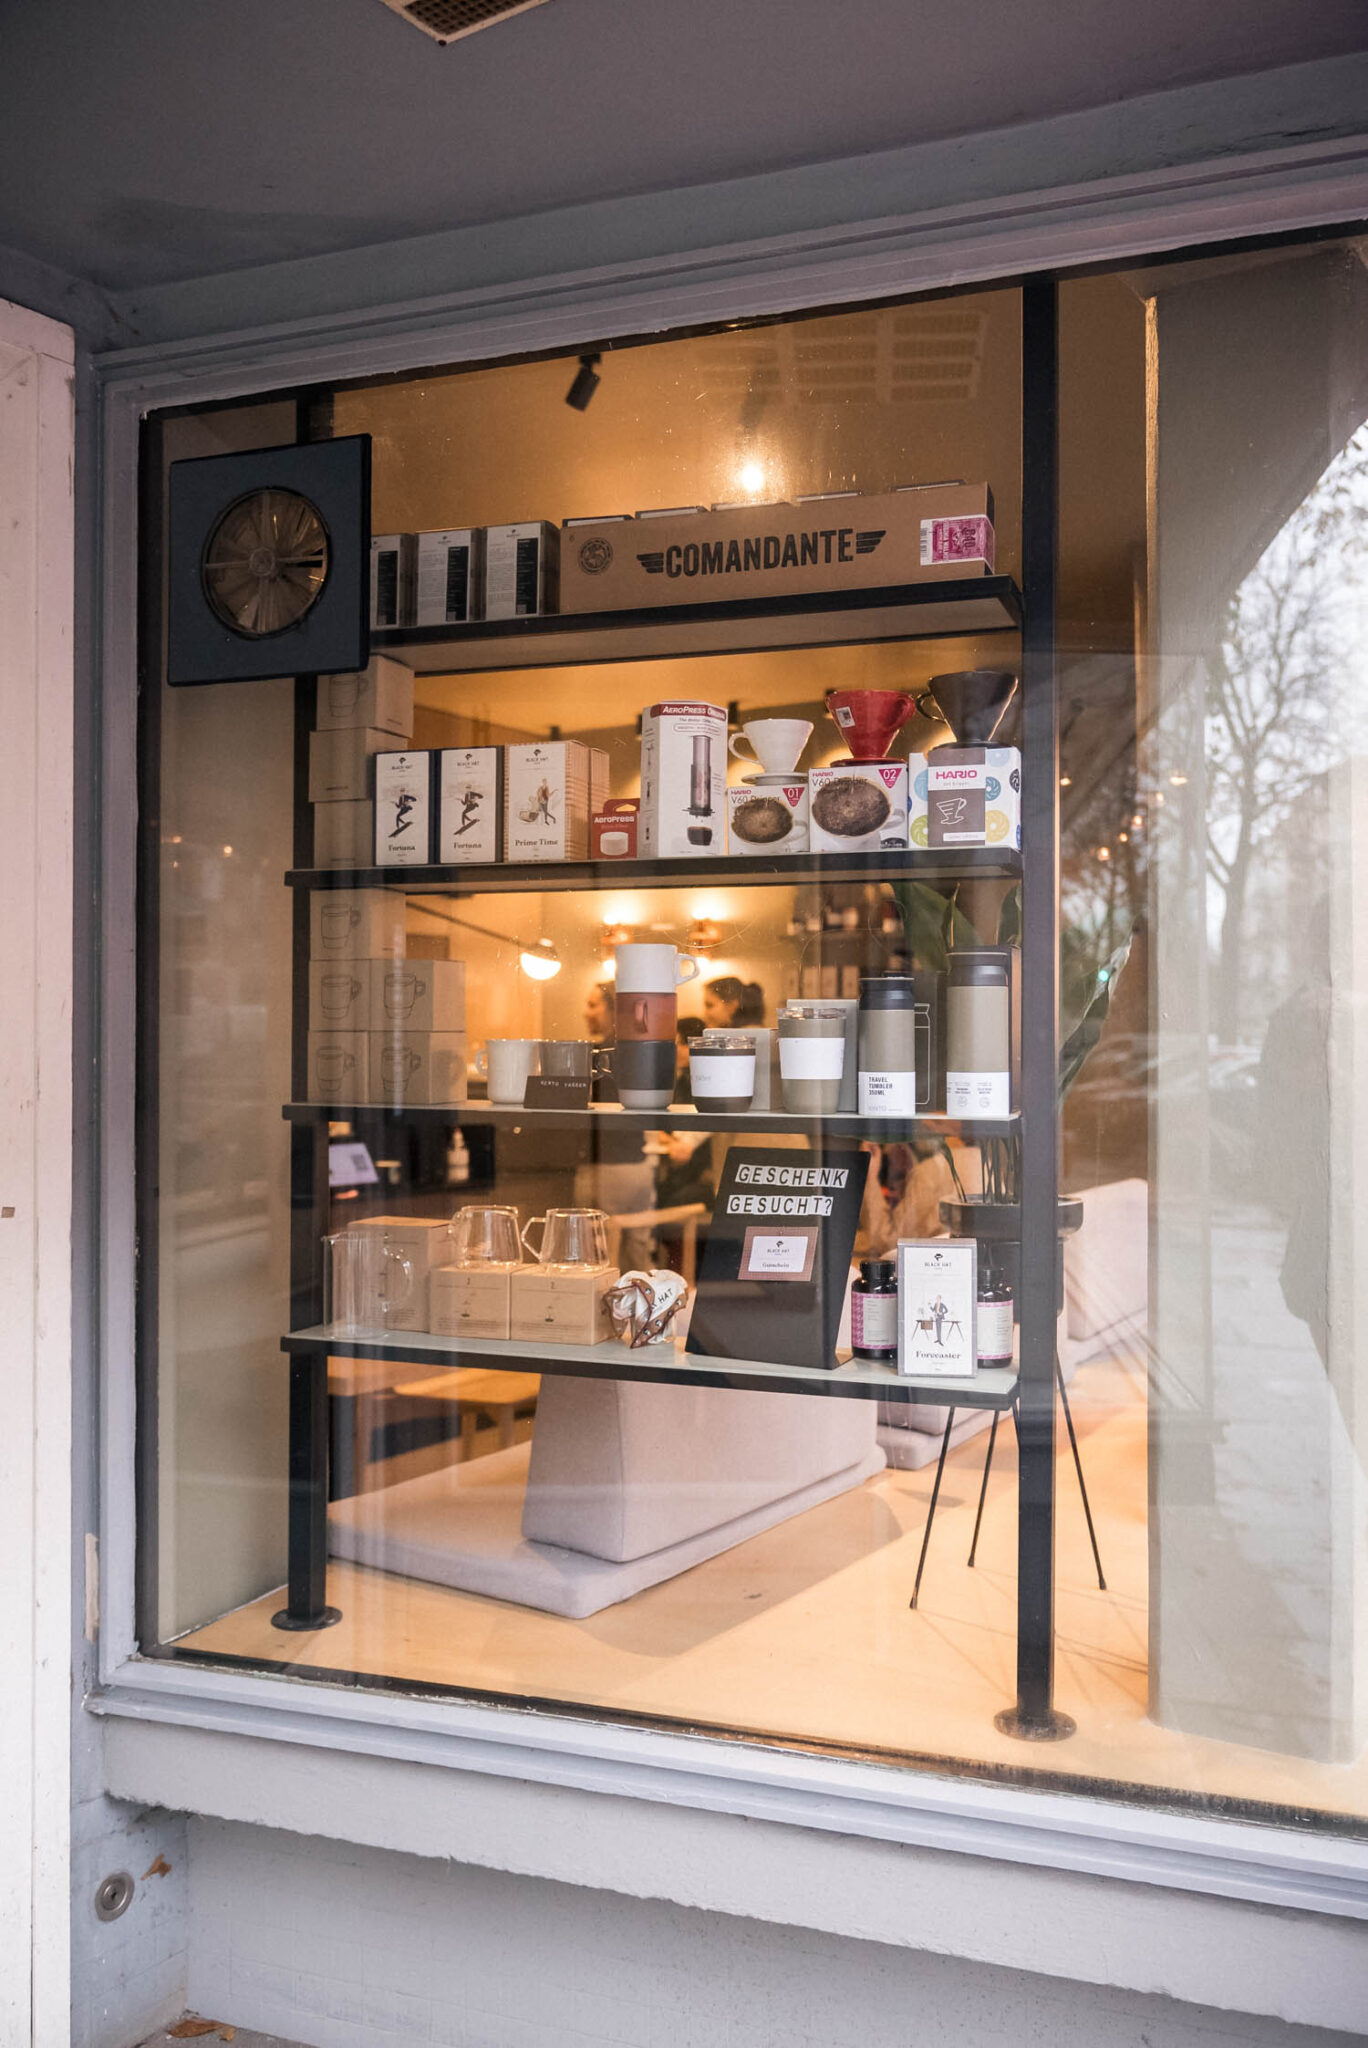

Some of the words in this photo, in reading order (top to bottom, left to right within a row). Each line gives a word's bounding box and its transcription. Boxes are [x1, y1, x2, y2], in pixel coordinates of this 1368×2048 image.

[665, 528, 854, 578] COMANDANTE
[883, 769, 896, 780] 02
[936, 769, 977, 780] HARIO
[811, 777, 830, 787] V60
[787, 788, 799, 799] 01
[731, 795, 748, 804] V60
[738, 1166, 845, 1187] GESCHENK
[729, 1196, 832, 1214] GESUCHT?
[658, 1288, 673, 1303] HAT
[916, 1351, 961, 1359] Forecaster
